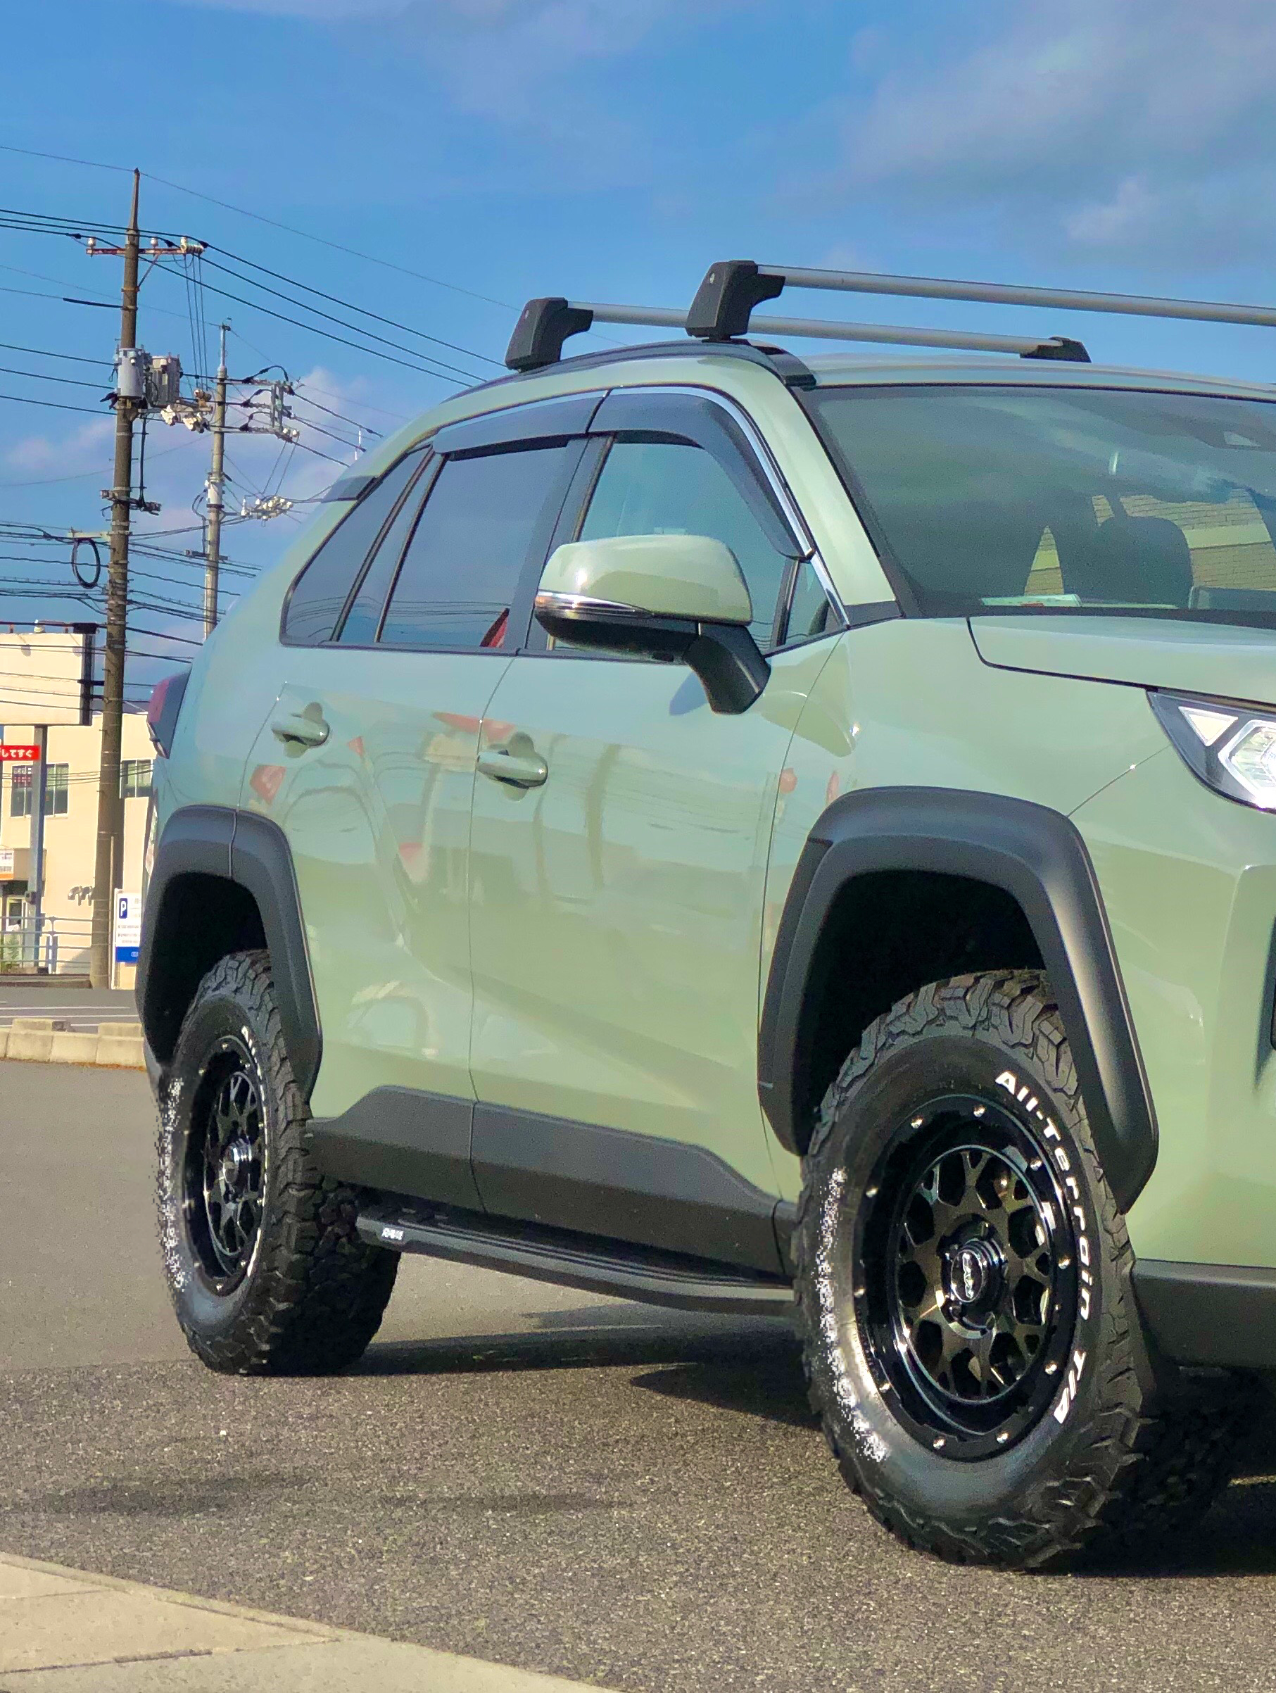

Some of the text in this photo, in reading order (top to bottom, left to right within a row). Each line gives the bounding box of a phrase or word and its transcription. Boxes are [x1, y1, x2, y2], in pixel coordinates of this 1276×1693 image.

[0, 748, 34, 758] してすぐ
[995, 1070, 1093, 1321] All-Terrain
